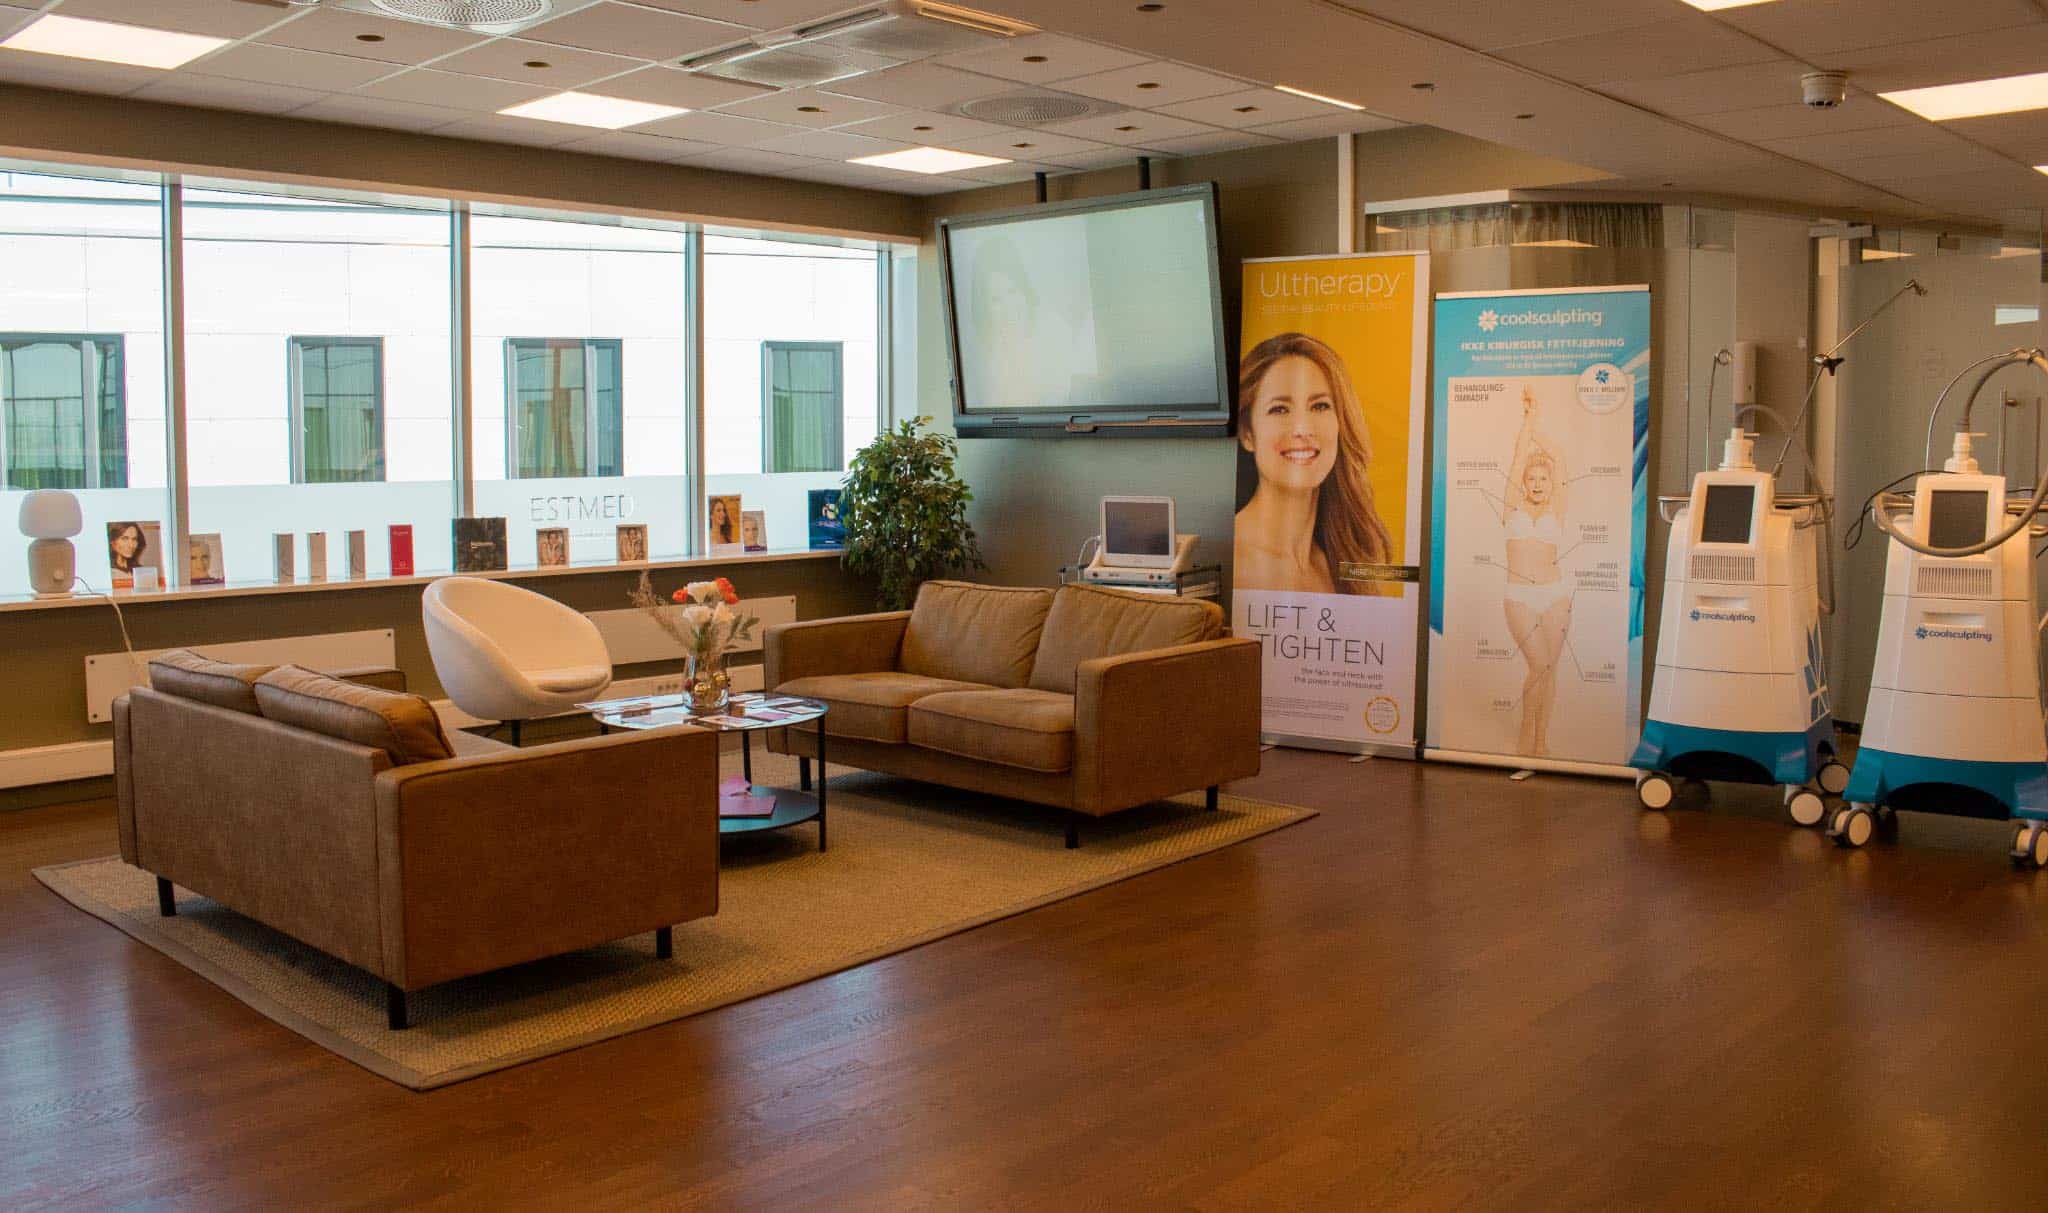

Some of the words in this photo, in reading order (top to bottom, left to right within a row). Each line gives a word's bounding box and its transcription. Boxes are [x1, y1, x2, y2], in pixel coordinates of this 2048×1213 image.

[1260, 271, 1400, 299] Ultherapy
[1500, 309, 1602, 327] coolsculpting
[1461, 342, 1485, 351] IKKE
[1487, 339, 1544, 350] KIRURGISK
[530, 495, 633, 521] ESTMED
[1248, 604, 1307, 630] LIFT
[1317, 607, 1335, 632] &
[1255, 633, 1384, 665] TIGHTEN
[1928, 629, 1993, 643] coolsculpting
